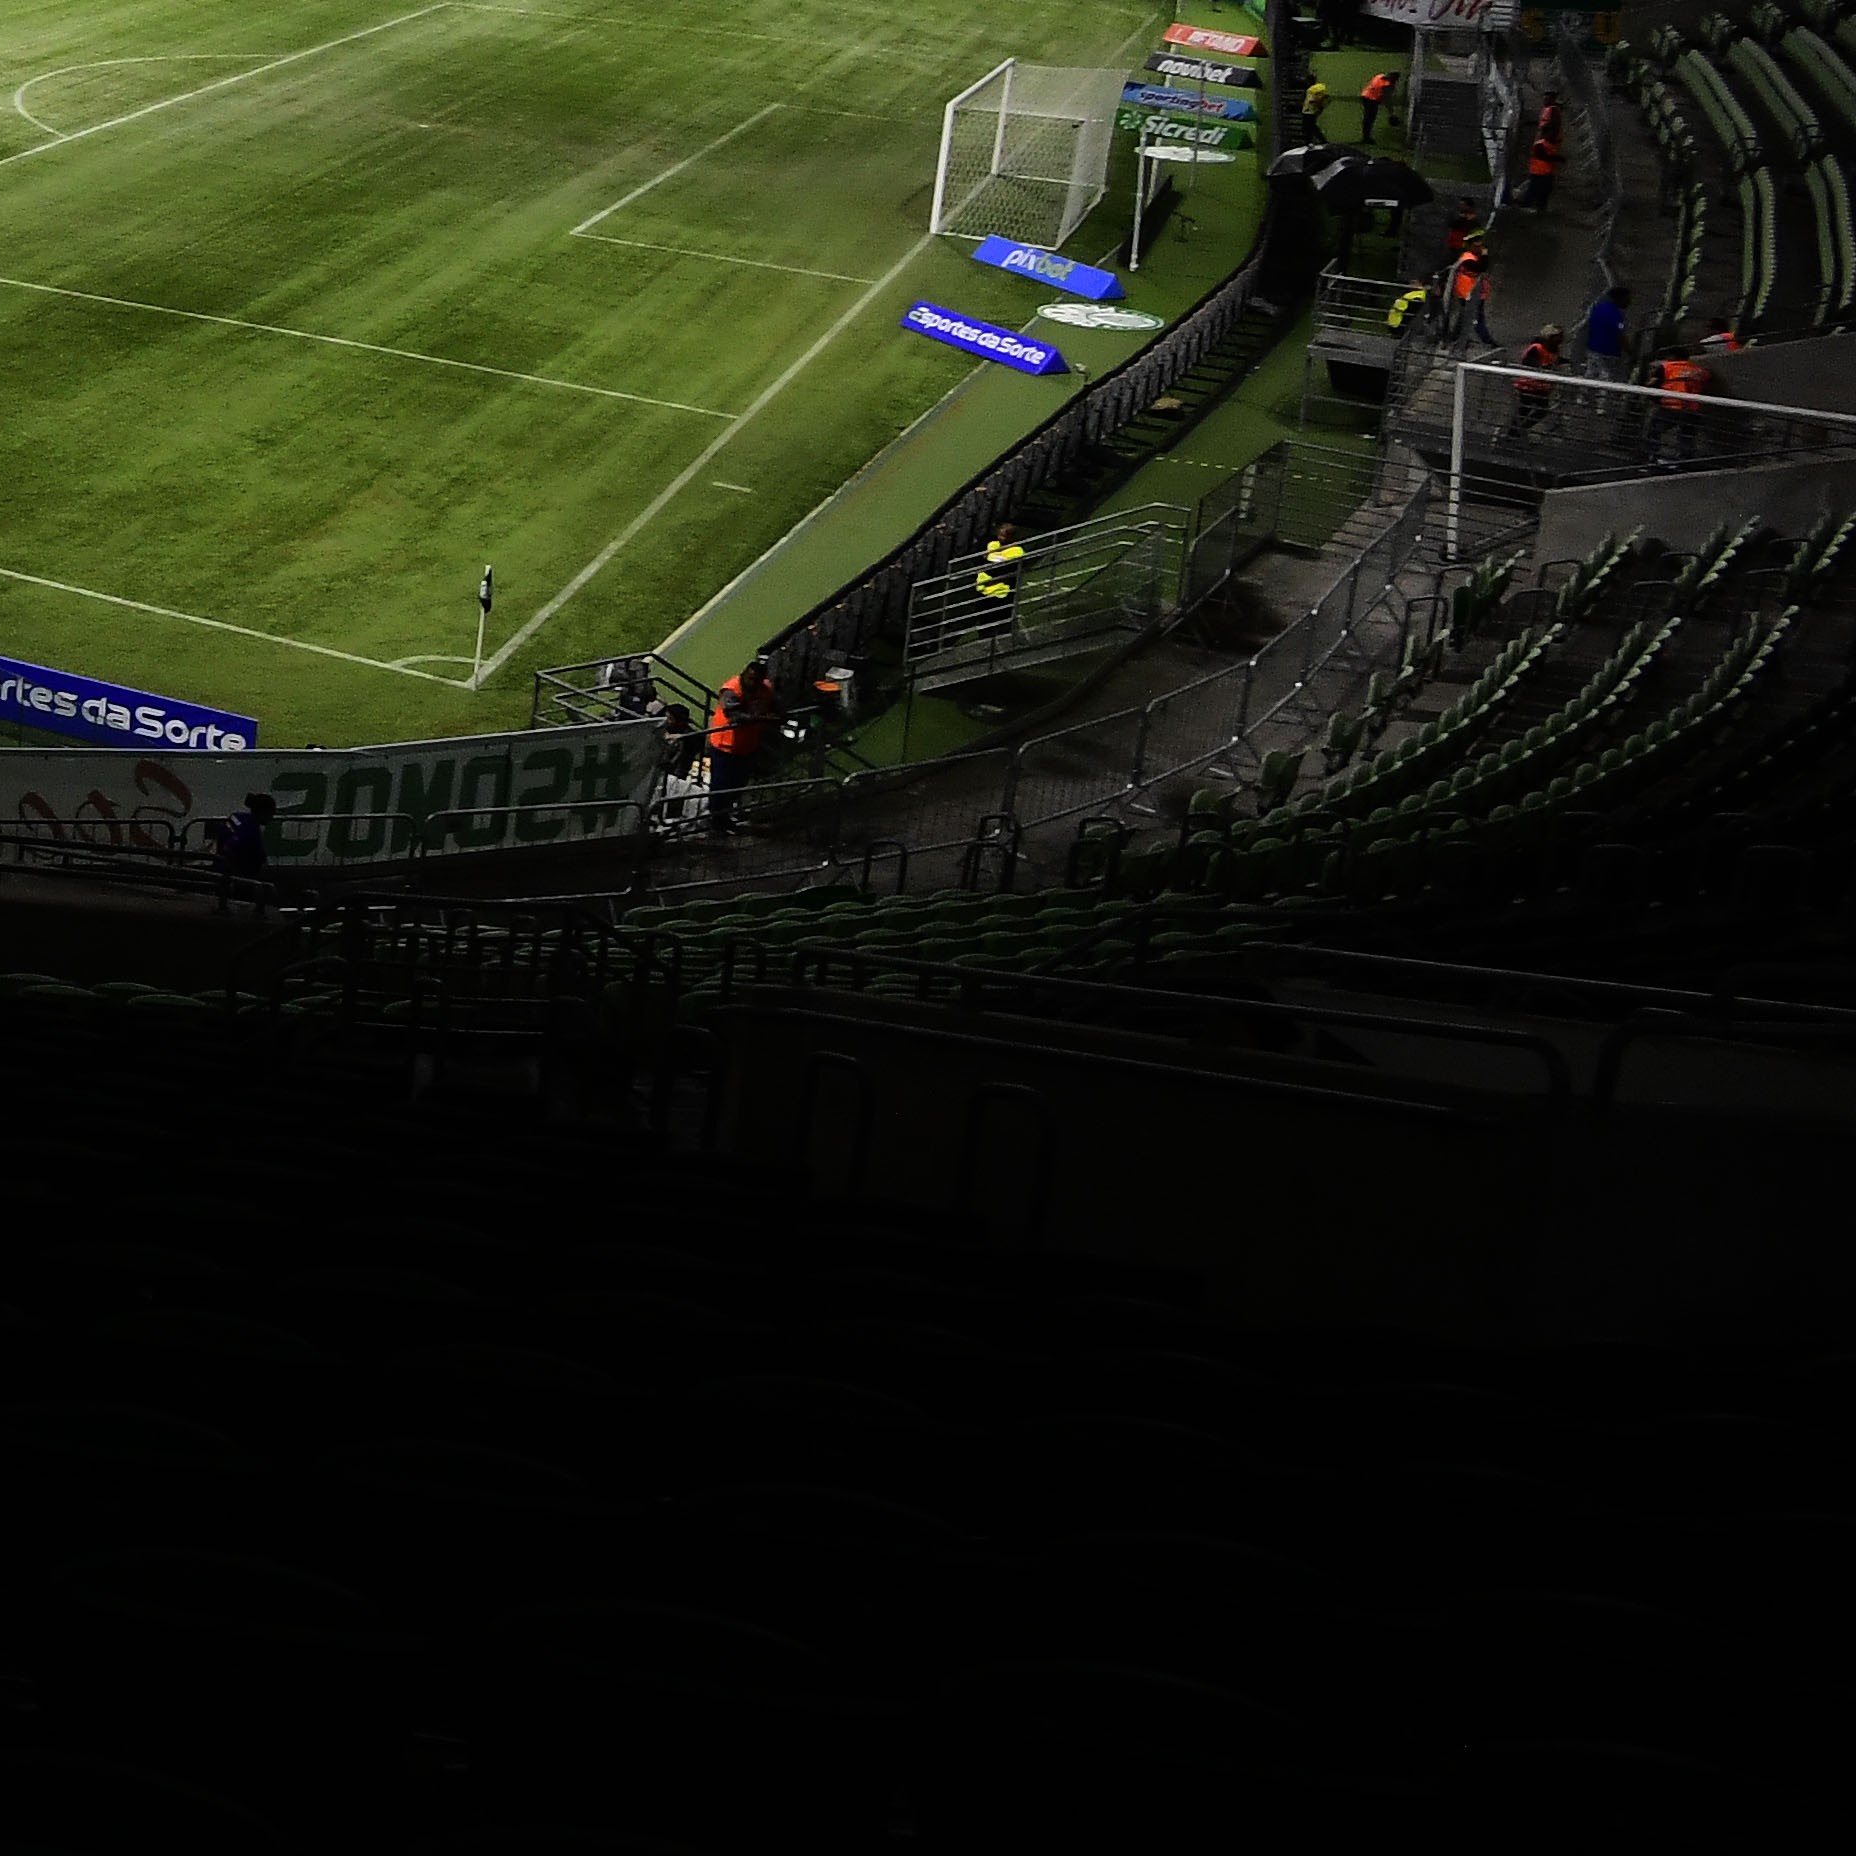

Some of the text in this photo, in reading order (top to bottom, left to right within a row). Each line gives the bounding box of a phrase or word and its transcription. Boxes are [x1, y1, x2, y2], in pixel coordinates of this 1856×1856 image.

[1156, 58, 1234, 84] novibet
[1139, 90, 1226, 114] sportingbet
[1144, 114, 1229, 146] Sicredi
[1001, 247, 1076, 282] pixbet
[907, 306, 981, 342] Esportes
[996, 336, 1046, 366] Sorte
[80, 696, 132, 732] da
[133, 706, 248, 751] Sorte
